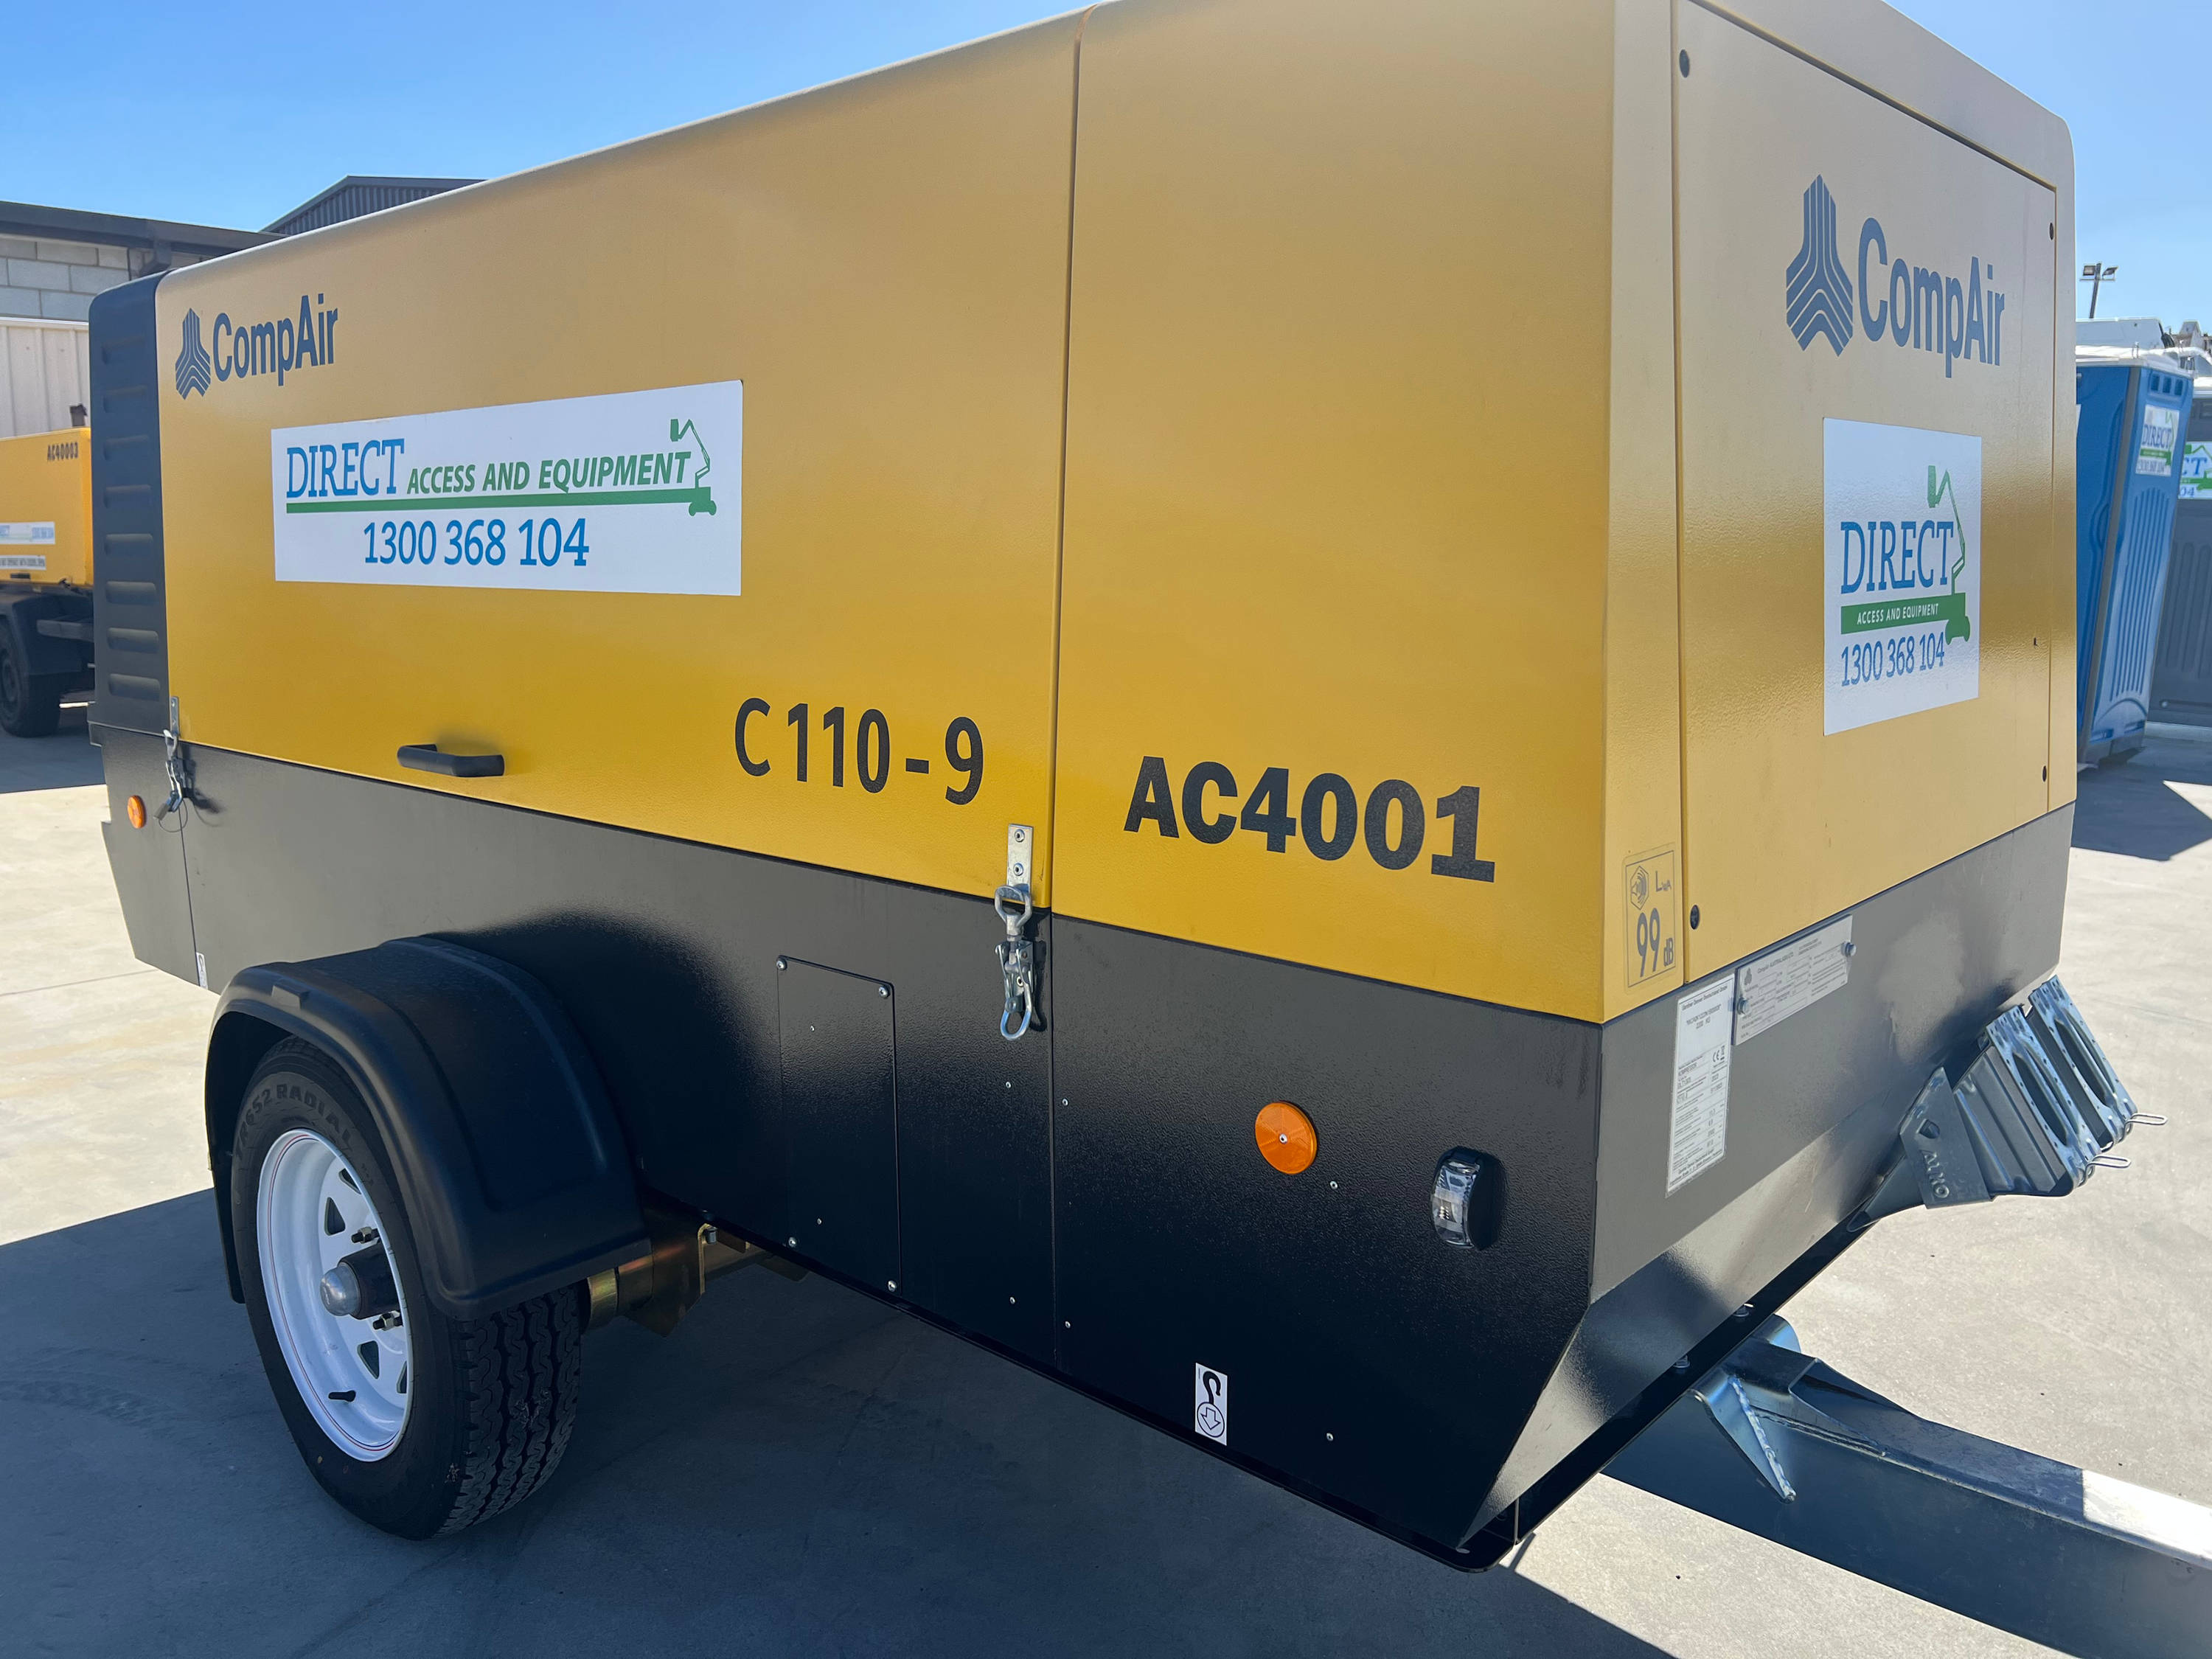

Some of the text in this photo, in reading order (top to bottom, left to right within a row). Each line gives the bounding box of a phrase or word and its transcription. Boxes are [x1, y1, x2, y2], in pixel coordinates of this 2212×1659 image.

[1857, 217, 2005, 379] CompAir
[212, 293, 338, 386] CompAir
[2141, 424, 2172, 449] DIRECT
[285, 437, 692, 500] DIRECT ACCESS AND EQUIPMENT
[363, 516, 591, 568] 1300 368 104
[1840, 519, 1955, 595] DIRECT
[1857, 603, 1939, 625] ACCESS AND EQUIPMENT
[1840, 631, 1945, 687] 1300 368 104
[1122, 755, 1496, 884] AC4001
[1637, 908, 1660, 978] 99
[1663, 937, 1674, 967] dB
